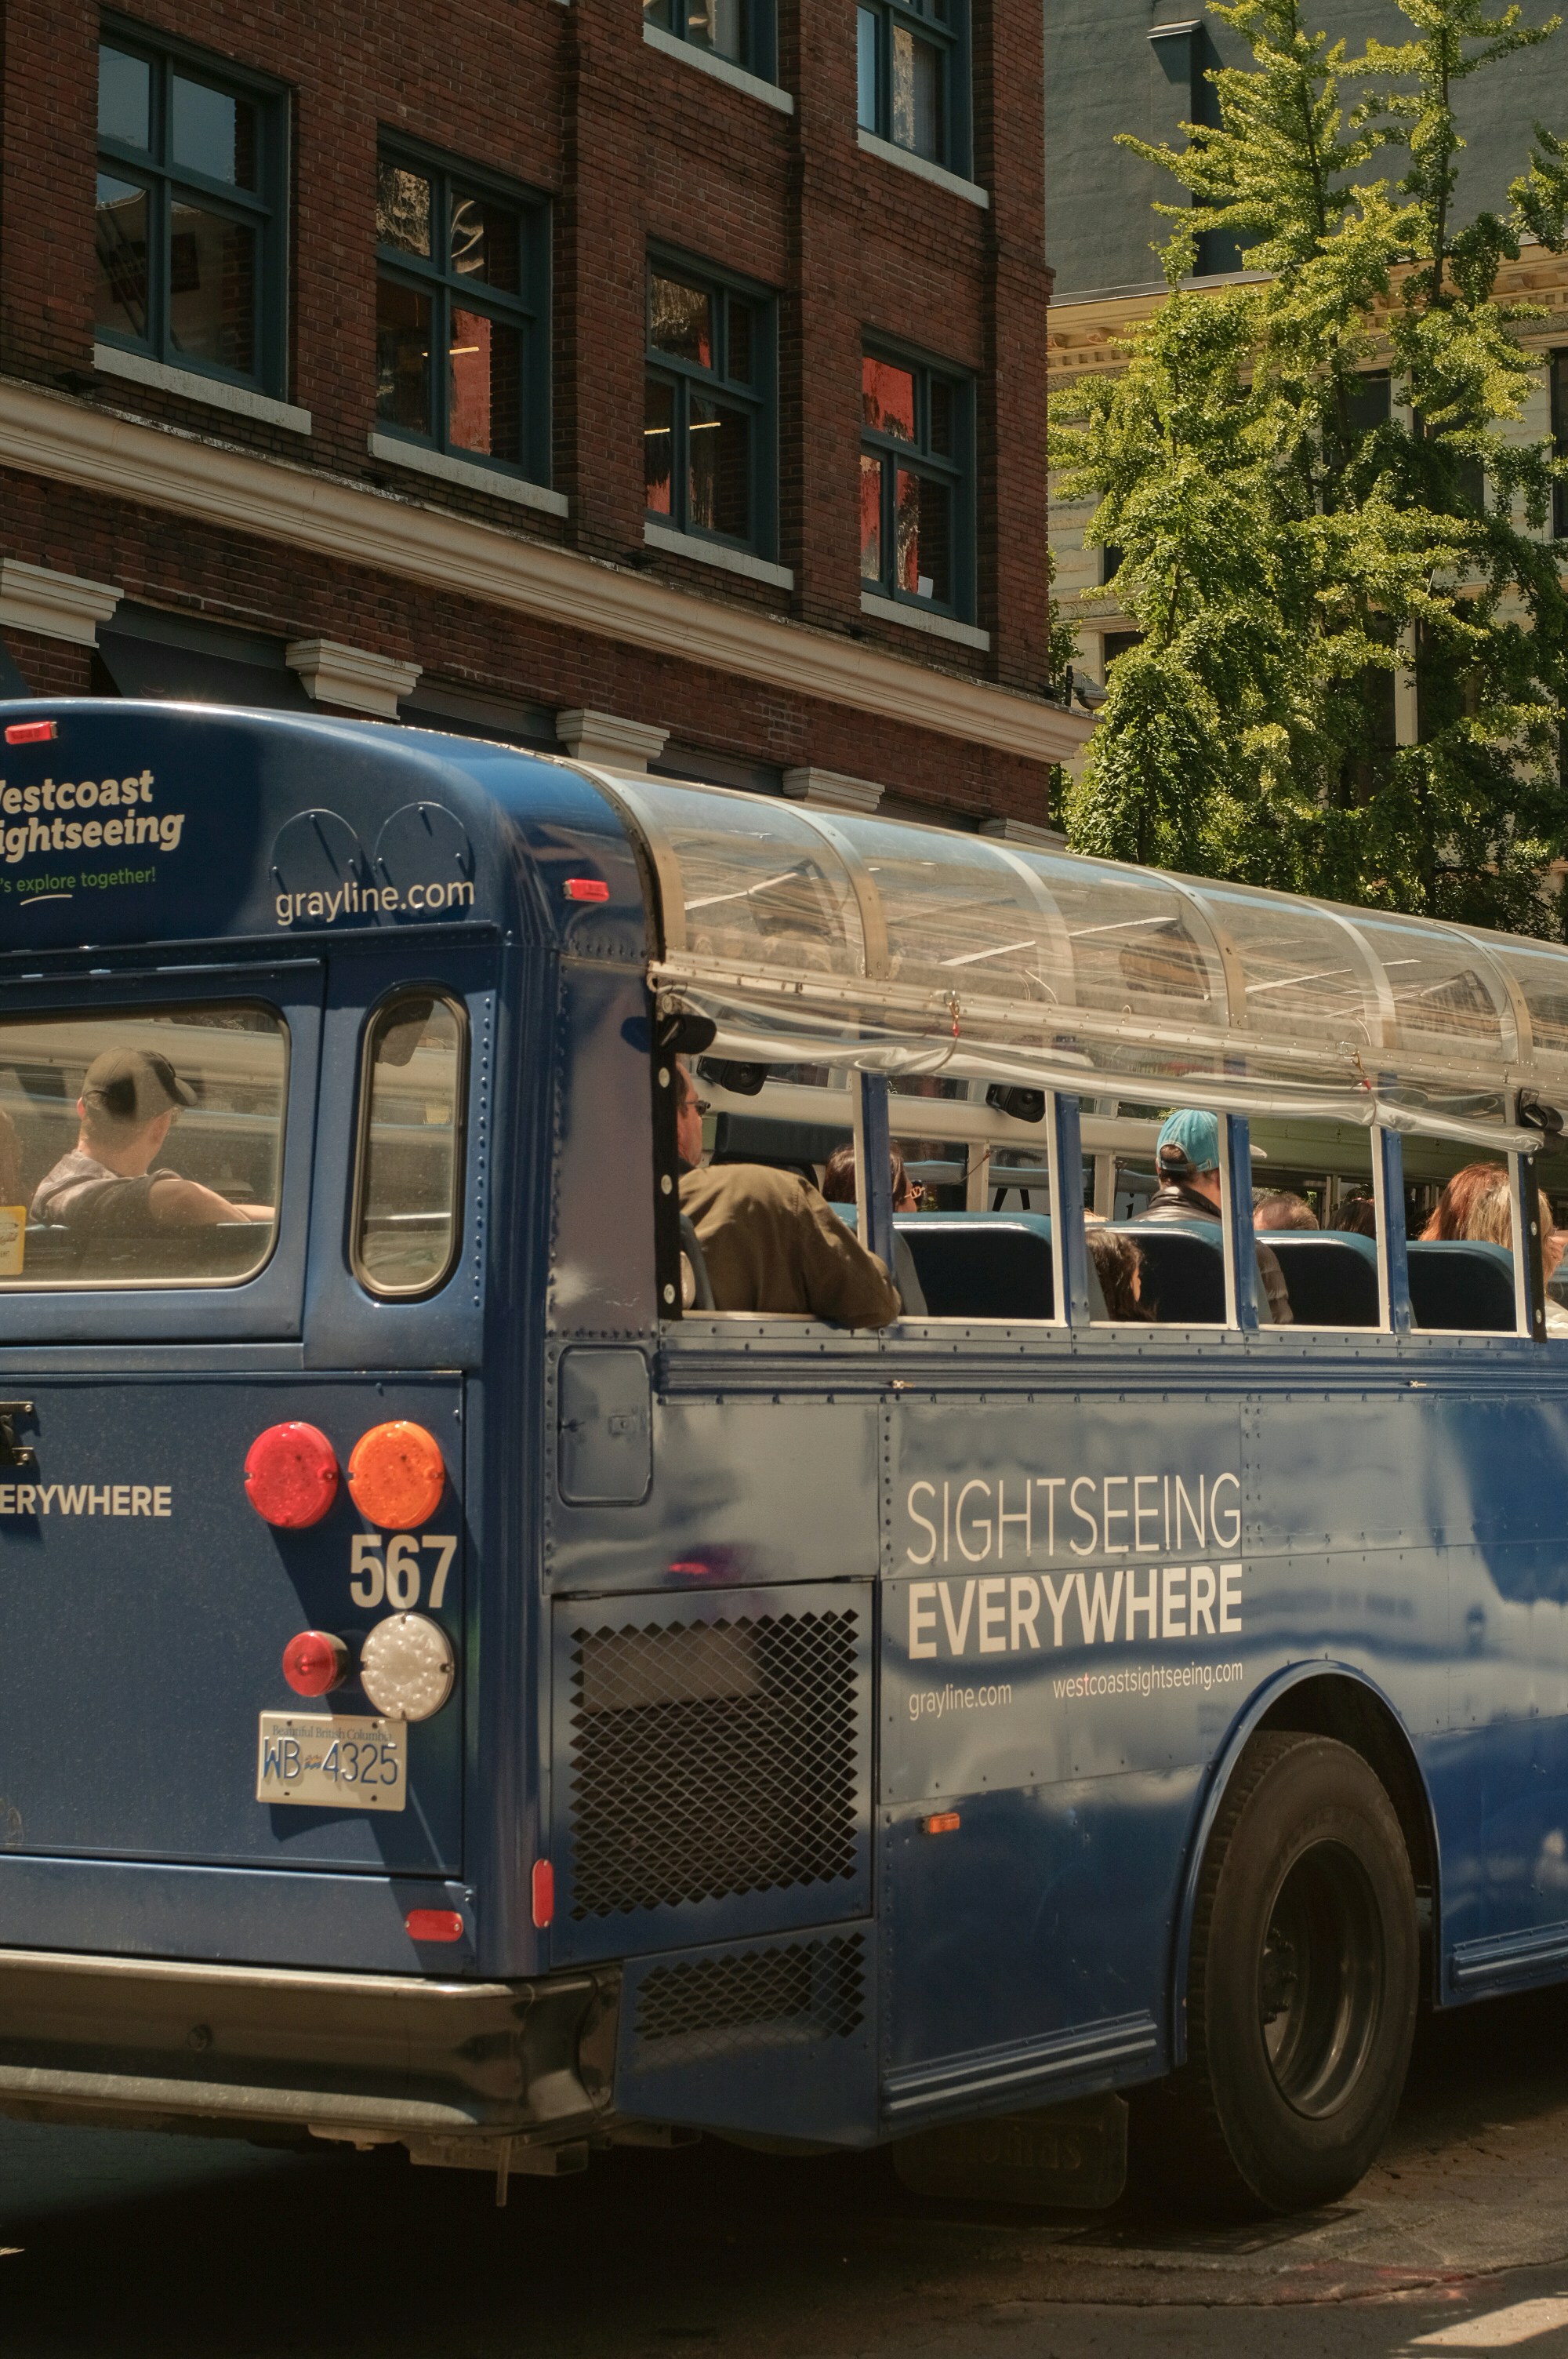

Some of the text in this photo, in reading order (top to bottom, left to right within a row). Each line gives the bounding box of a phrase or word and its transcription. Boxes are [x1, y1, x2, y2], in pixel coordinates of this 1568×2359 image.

[0, 809, 186, 863] ightseeing
[16, 874, 76, 893] explore
[81, 866, 156, 889] together!
[274, 881, 475, 925] grayline.com
[0, 1483, 172, 1518] ERYWHERE
[906, 1472, 1241, 1565] SIGHTSEEING
[350, 1533, 458, 1609] 567
[908, 1563, 1243, 1660] EVERYWHERE
[909, 1661, 1243, 1721] grayline.com westcoastsightseeing.com
[272, 1725, 314, 1738] Beautiful
[315, 1726, 345, 1739] British
[263, 1736, 398, 1786] WB 4325
